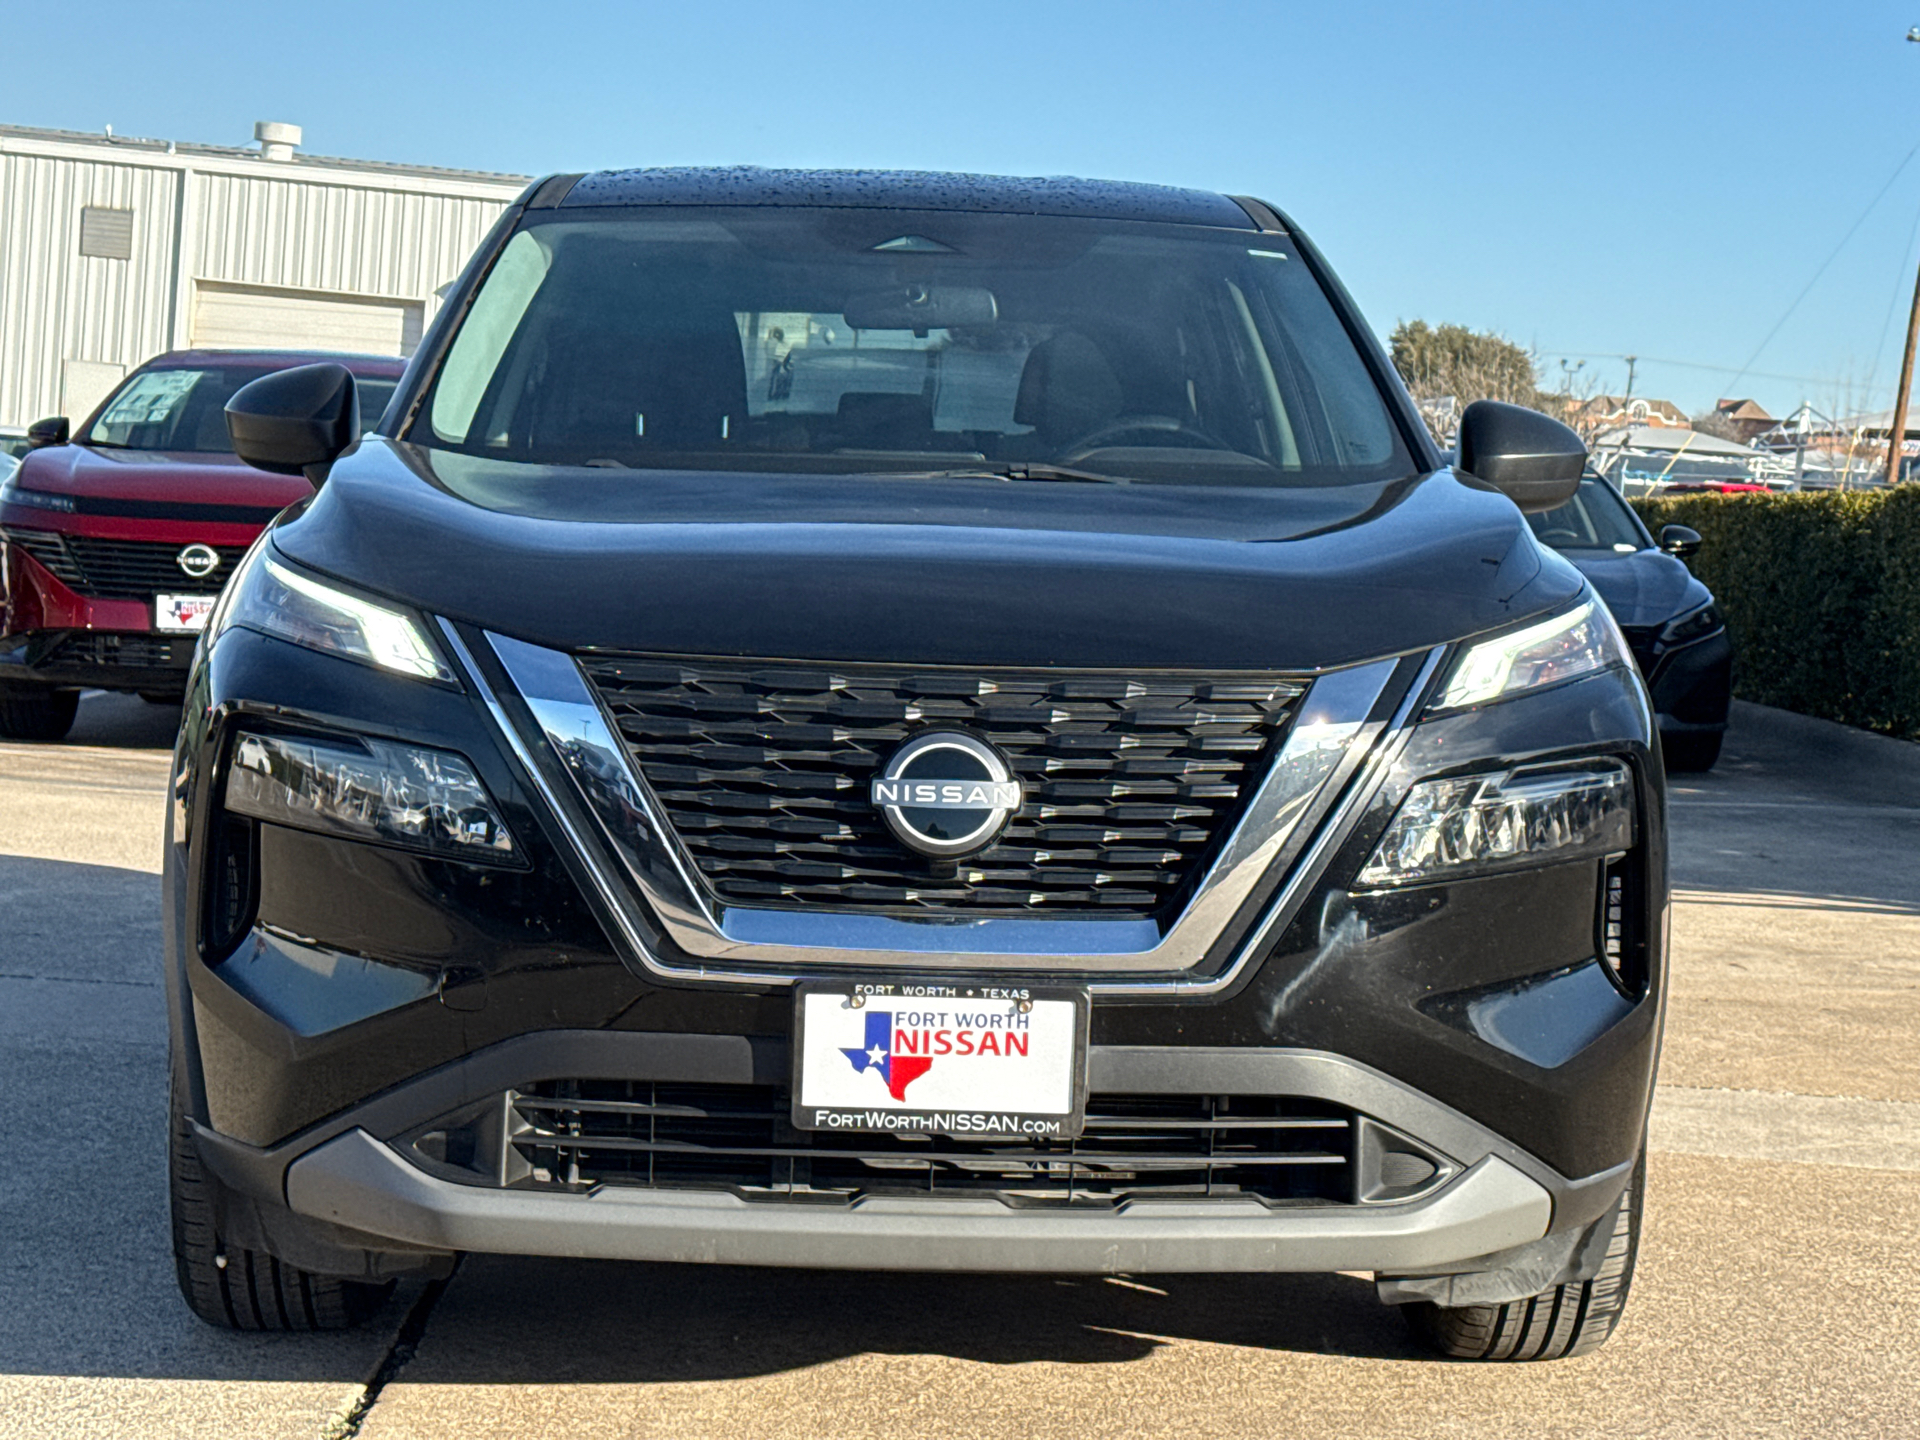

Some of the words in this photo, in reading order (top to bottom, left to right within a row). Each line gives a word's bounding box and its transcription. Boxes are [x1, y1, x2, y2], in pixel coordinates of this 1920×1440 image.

[876, 783, 1014, 804] NISSAN
[855, 984, 895, 995] FORT
[902, 986, 956, 997] WORTH
[981, 988, 1030, 1000] TEXAS
[895, 1011, 948, 1028] FORT
[955, 1013, 1029, 1030] WORTH
[894, 1029, 1029, 1057] NISSAN
